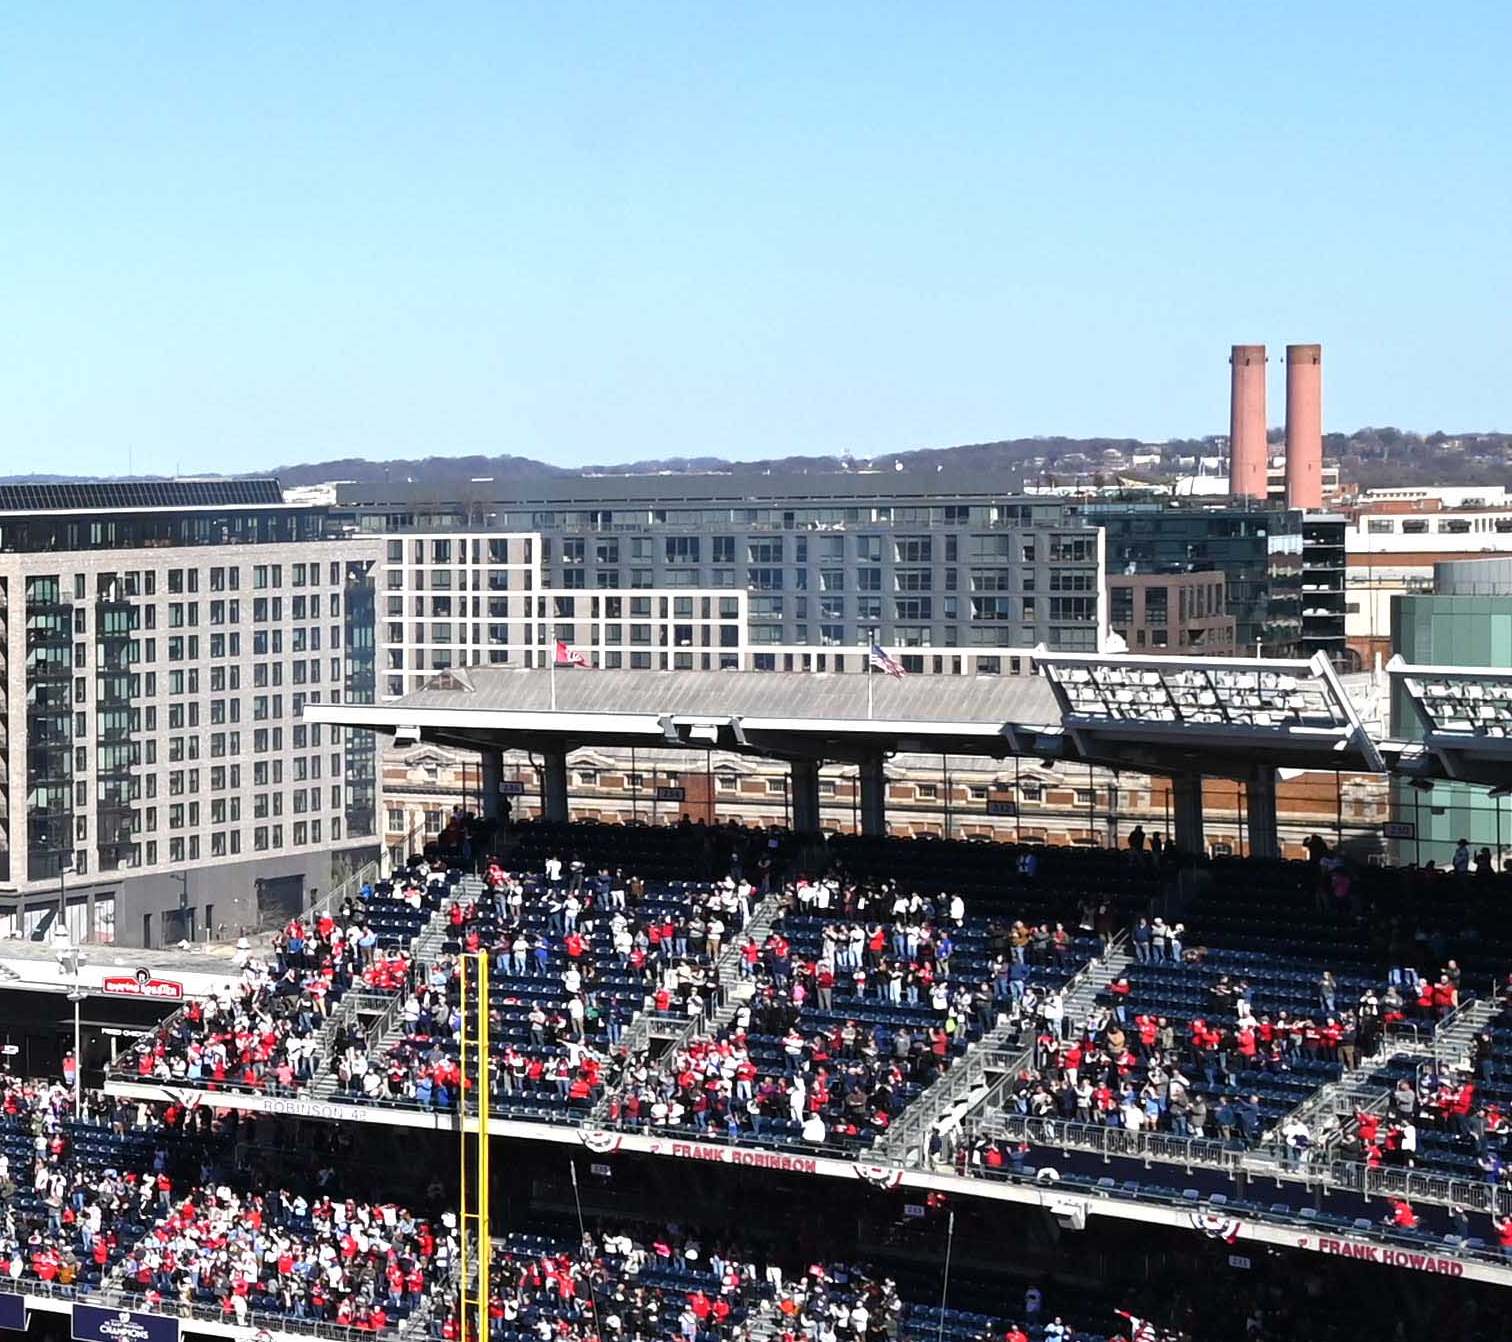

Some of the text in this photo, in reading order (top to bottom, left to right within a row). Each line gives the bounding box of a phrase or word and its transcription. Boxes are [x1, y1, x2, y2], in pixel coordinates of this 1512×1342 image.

[264, 1100, 343, 1119] ROBINSON
[671, 1143, 817, 1173] FRANK ROBINSON
[1318, 1238, 1464, 1278] FRANK HOWARD
[99, 1323, 150, 1340] CHAMPIONS
